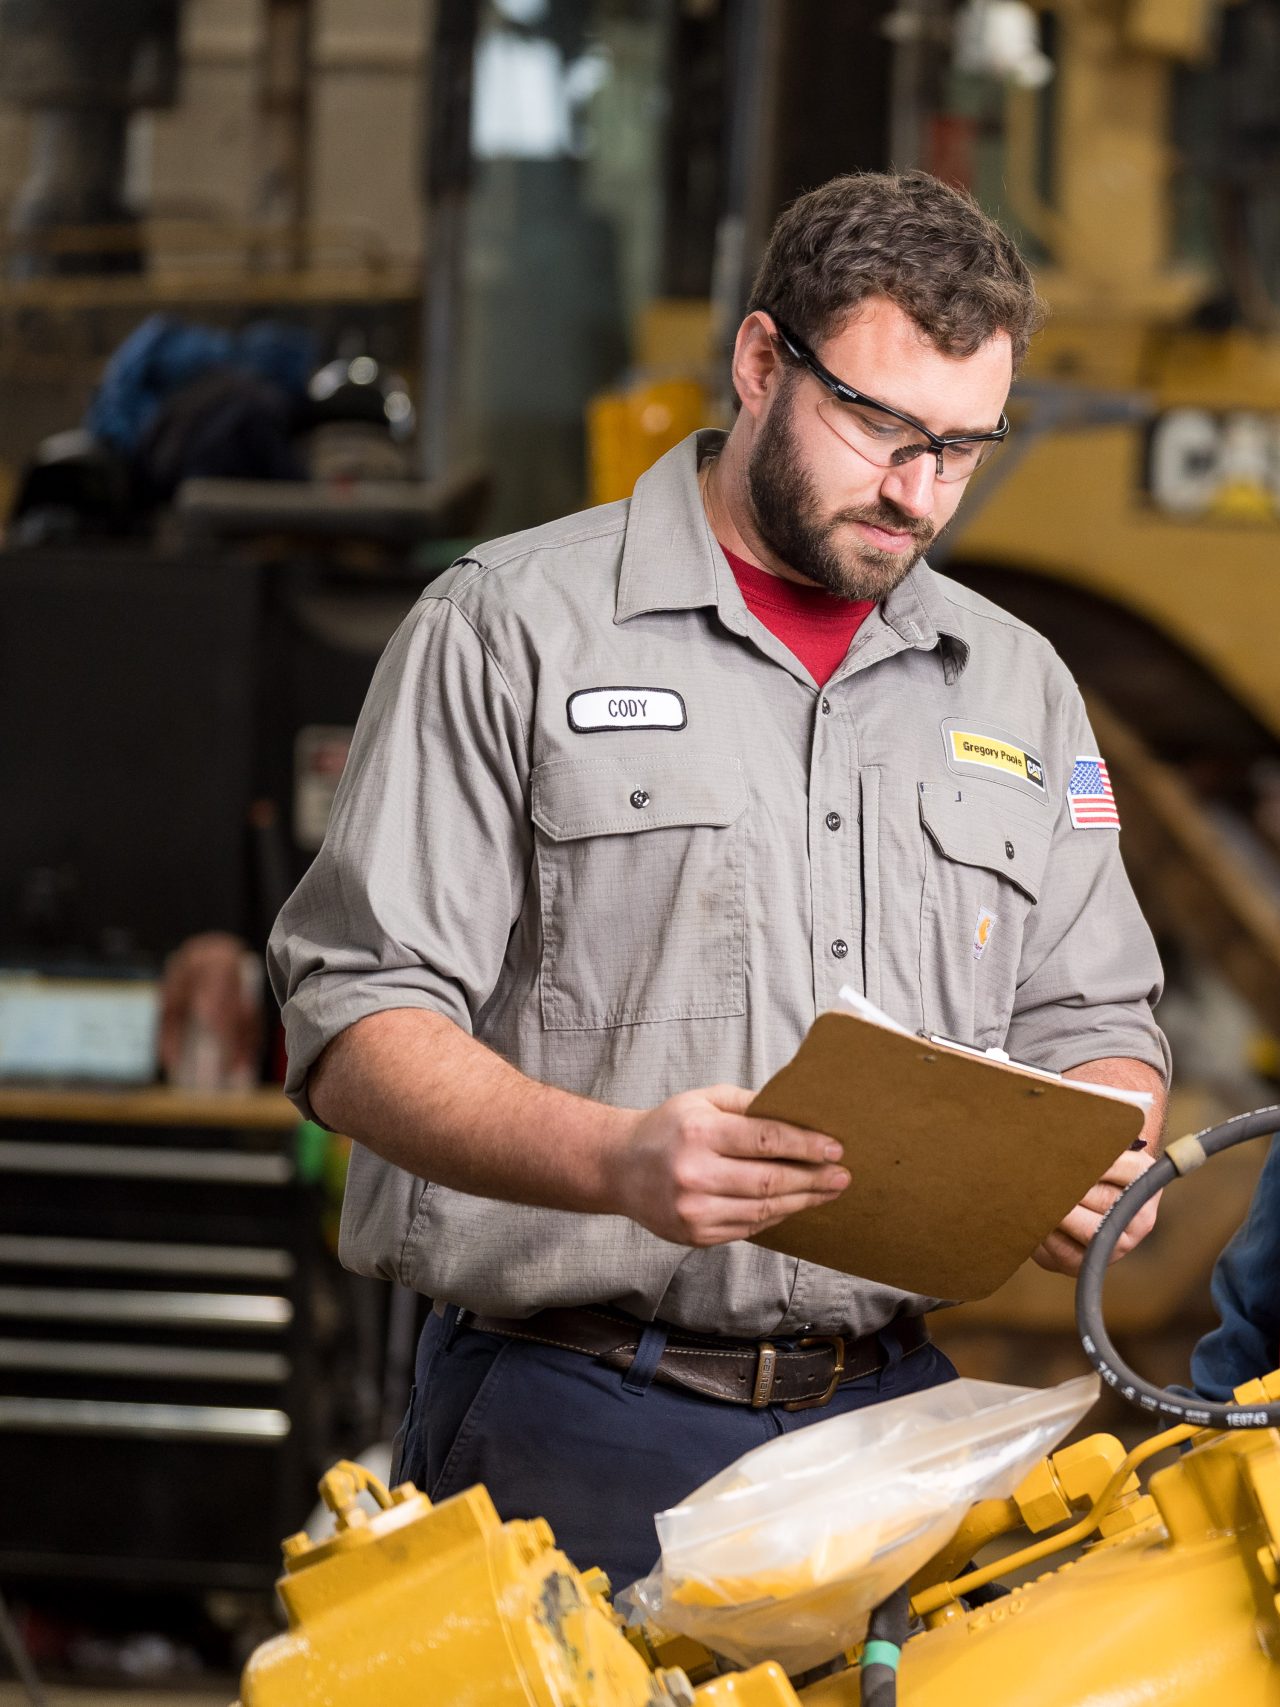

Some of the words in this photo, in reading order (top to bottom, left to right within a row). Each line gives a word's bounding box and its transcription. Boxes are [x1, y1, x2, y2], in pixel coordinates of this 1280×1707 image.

[608, 699, 648, 718] CODY
[963, 741, 999, 760] Gregory
[1001, 750, 1023, 768] Poole
[1026, 759, 1043, 781] CAT
